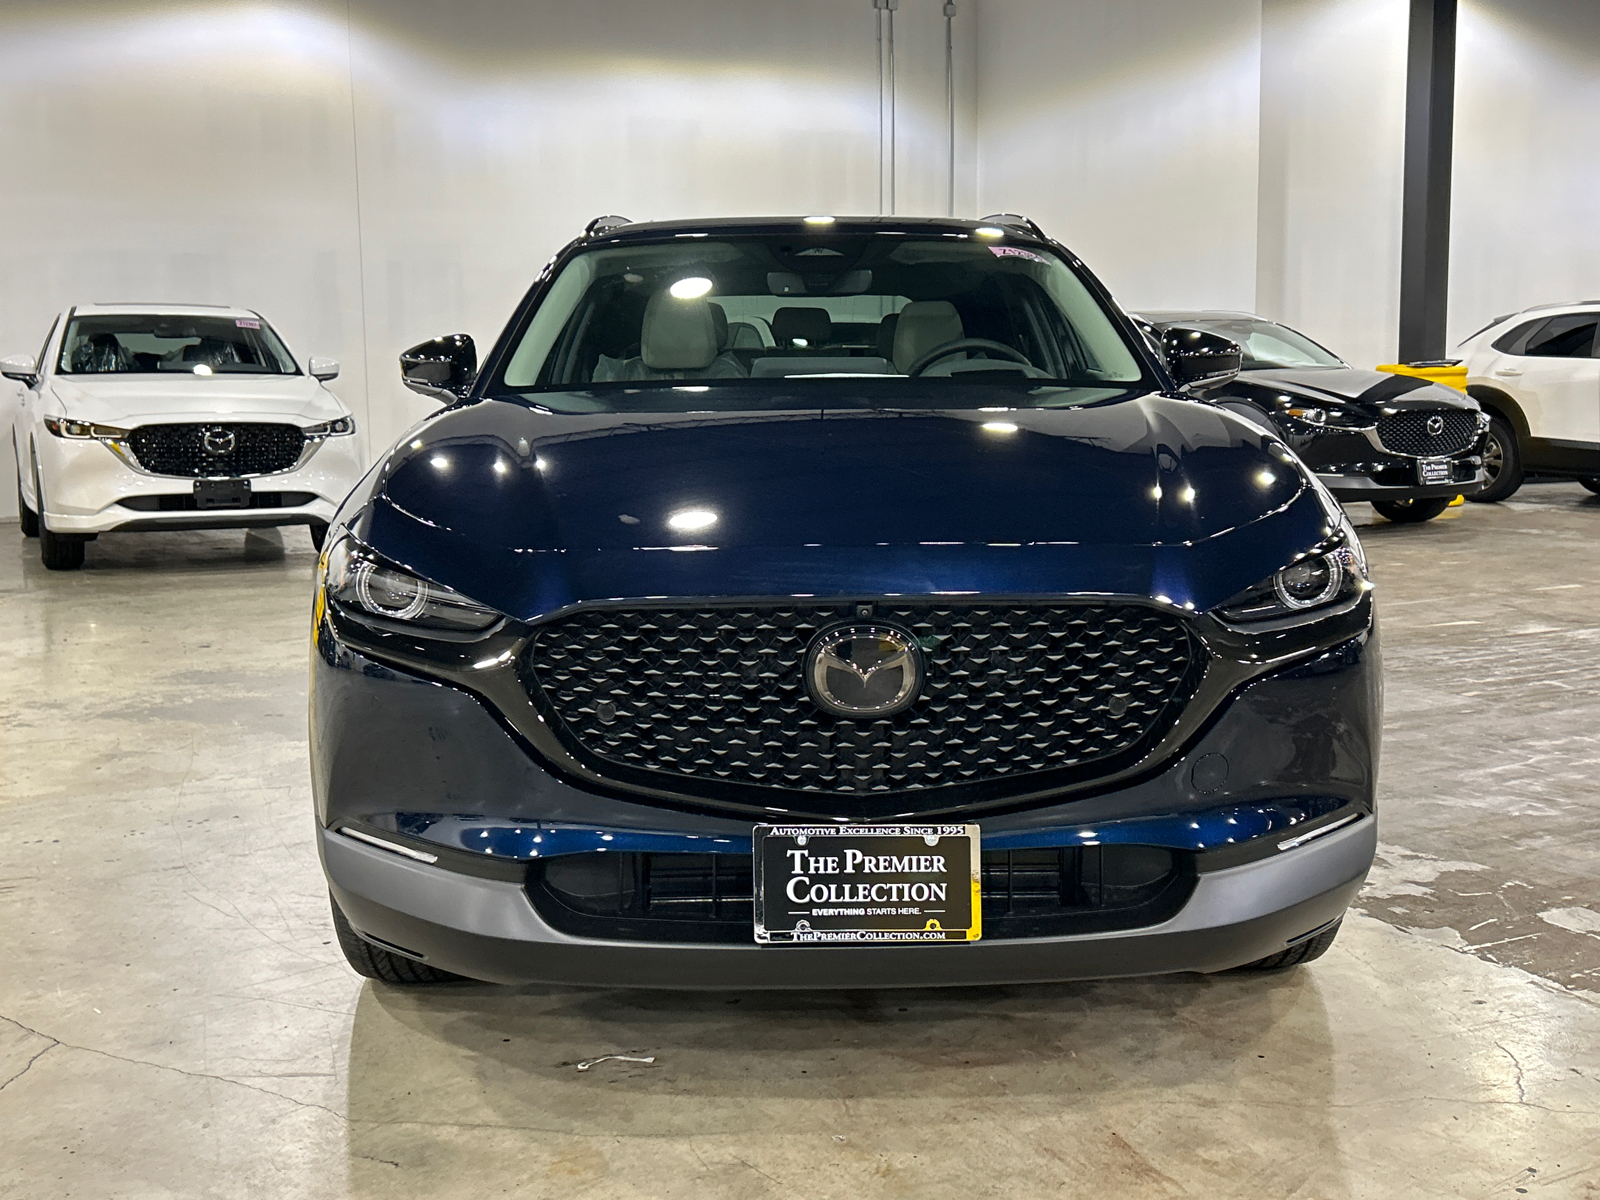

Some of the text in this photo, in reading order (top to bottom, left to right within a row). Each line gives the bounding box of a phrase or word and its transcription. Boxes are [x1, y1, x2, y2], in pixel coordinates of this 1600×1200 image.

[770, 826, 964, 835] AUTOMOTIVE EXCELLENCE SINCE 1995
[786, 849, 947, 874] THE PREMIER
[786, 876, 947, 903] COLLECTION
[811, 907, 922, 916] EVERYTHING STARTS HERE.
[790, 931, 946, 941] THEPREMIERCOLLECTION.COM
